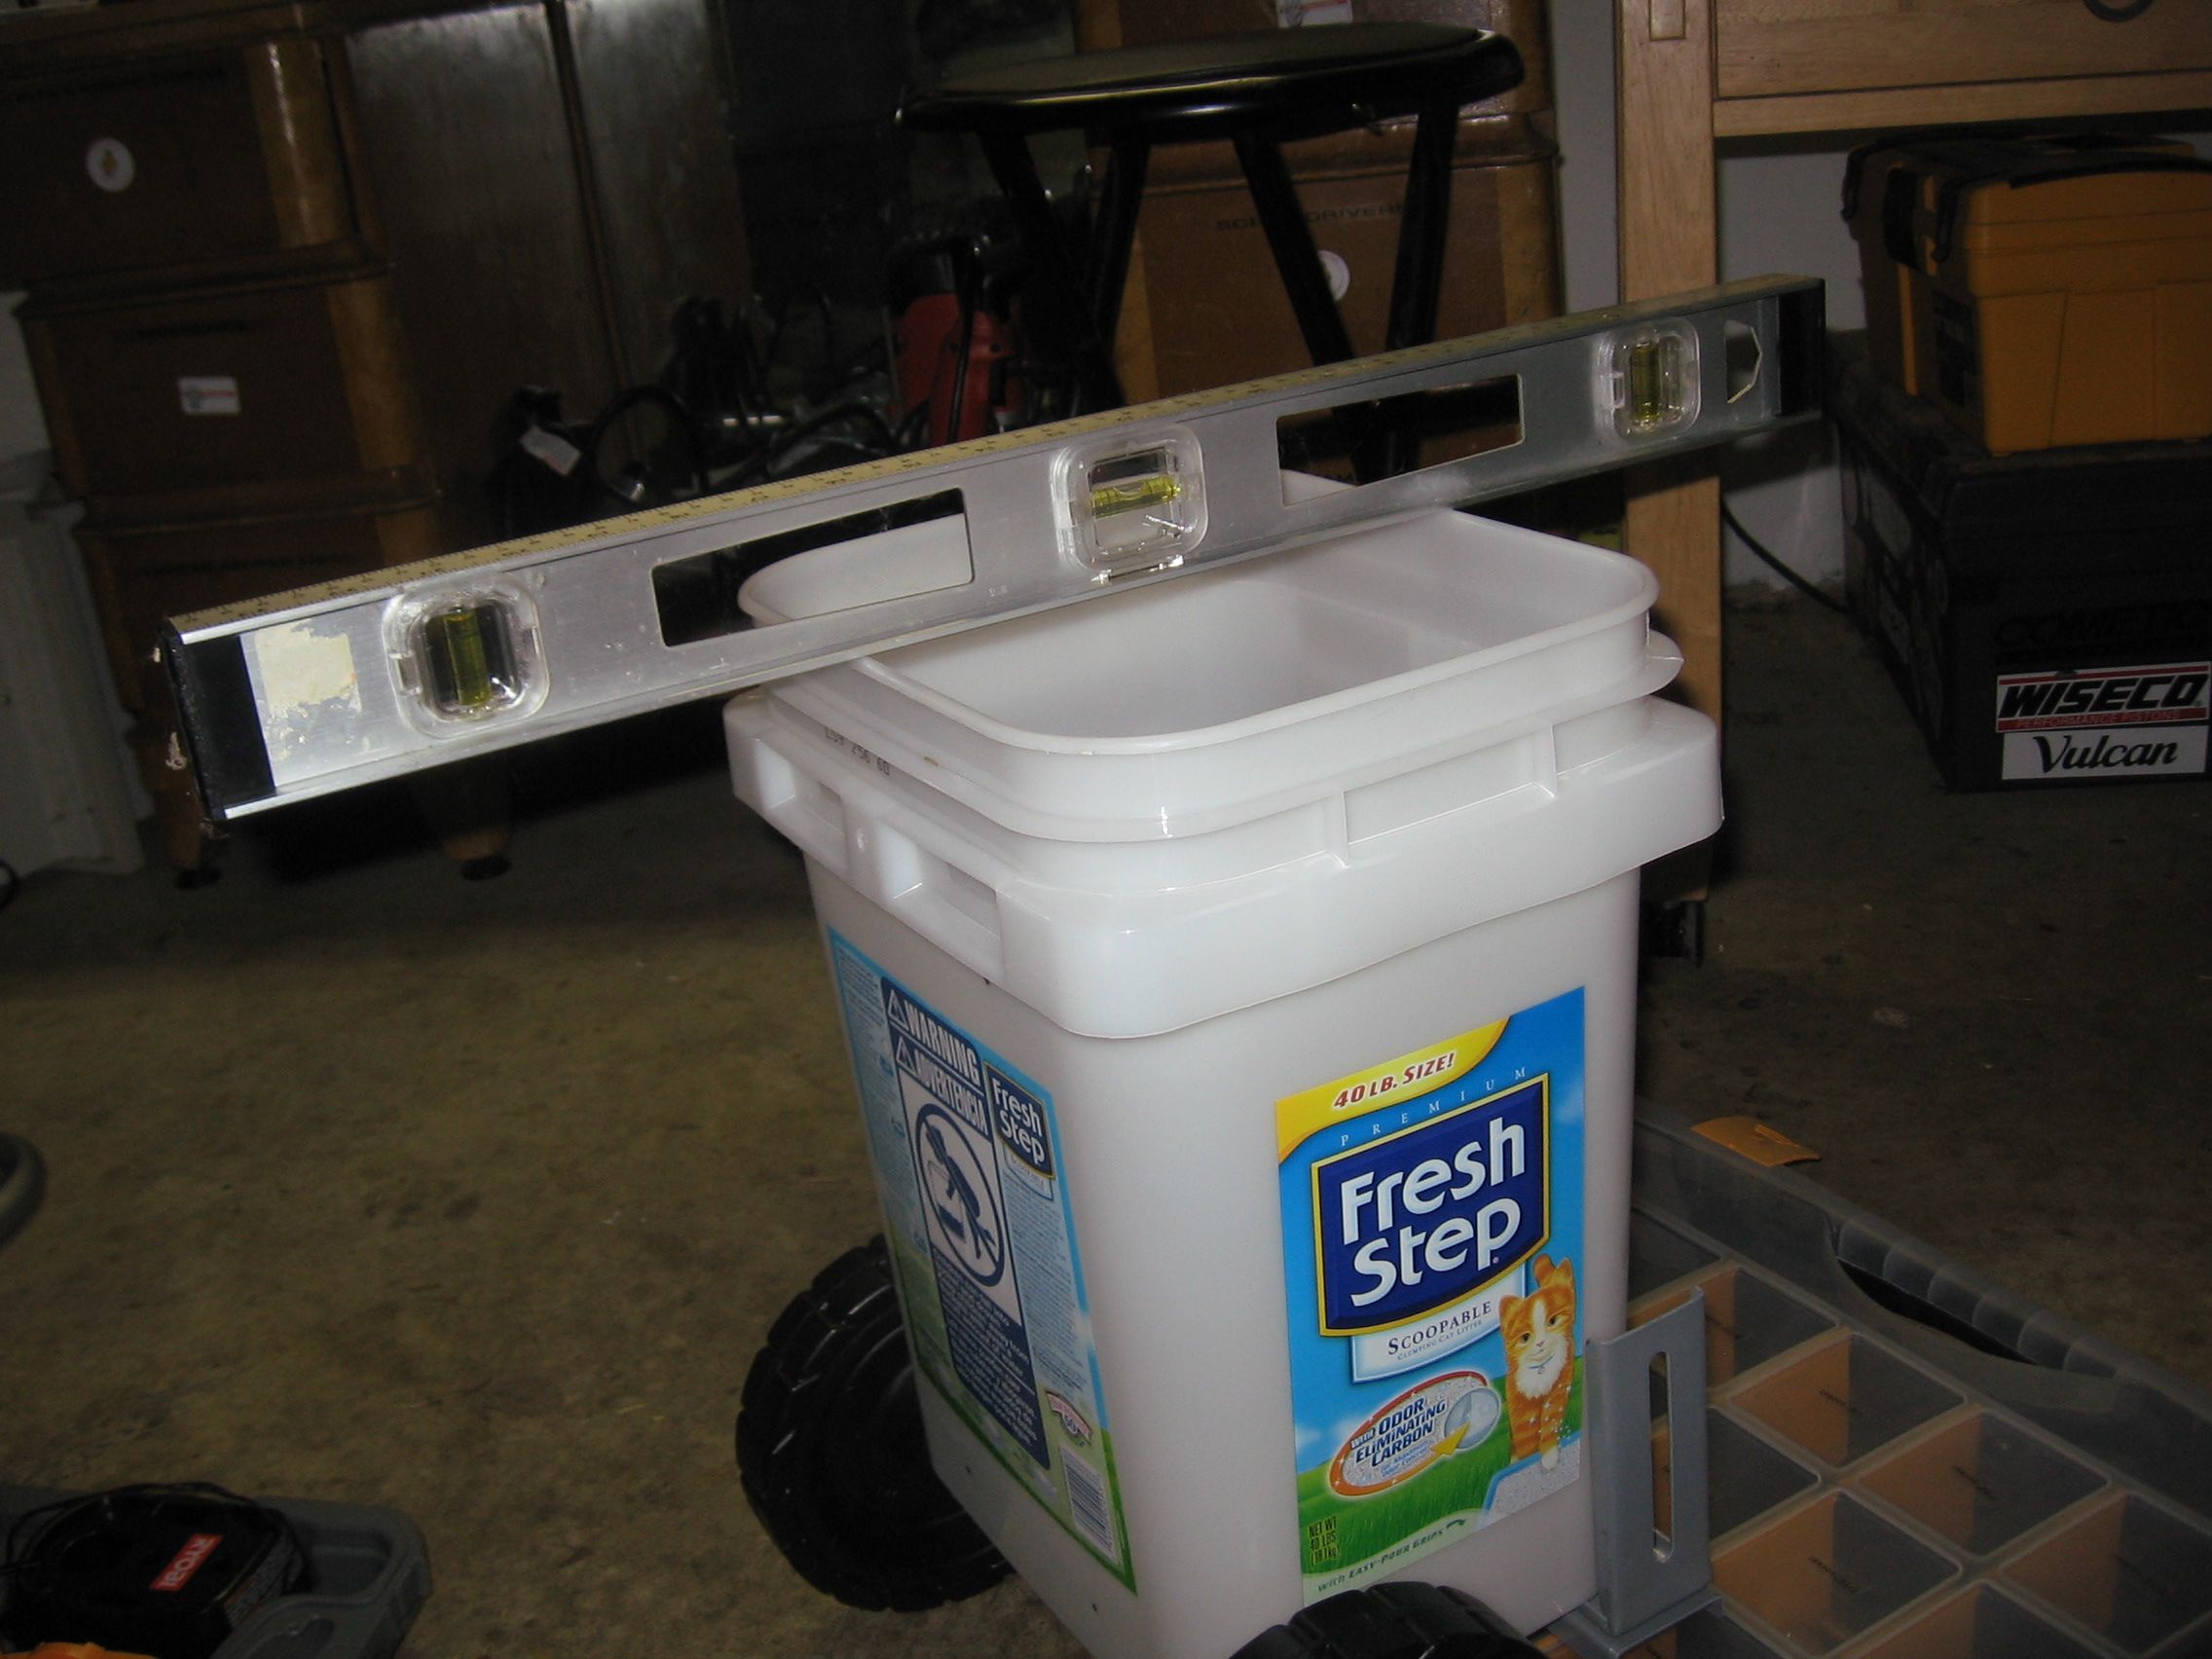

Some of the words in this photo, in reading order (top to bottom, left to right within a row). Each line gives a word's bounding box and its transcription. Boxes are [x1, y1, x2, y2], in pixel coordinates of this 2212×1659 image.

[1998, 674, 2209, 719] WISECO
[2016, 713, 2118, 729] PERFORMANCE
[2121, 709, 2181, 723] PISTONS
[2033, 735, 2178, 773] Vulcan
[904, 999, 982, 1086] WARNING
[991, 1076, 1043, 1138] Fresh
[1333, 1087, 1365, 1109] 40
[1368, 1076, 1398, 1097] LB.
[1402, 1051, 1456, 1085] SIZE!
[1340, 1067, 1527, 1147] PREMIUM
[1000, 1111, 1046, 1166] Step
[1341, 1117, 1526, 1245] Fresh
[1350, 1198, 1521, 1308] Step
[1387, 1301, 1492, 1355] SCOOPABLE
[1372, 1419, 1434, 1467] CARBON
[1379, 1397, 1424, 1435] ODOR
[1309, 1521, 1323, 1538] NET
[1325, 1516, 1338, 1531] WT
[1310, 1536, 1320, 1551] 40
[1322, 1530, 1337, 1546] LBS
